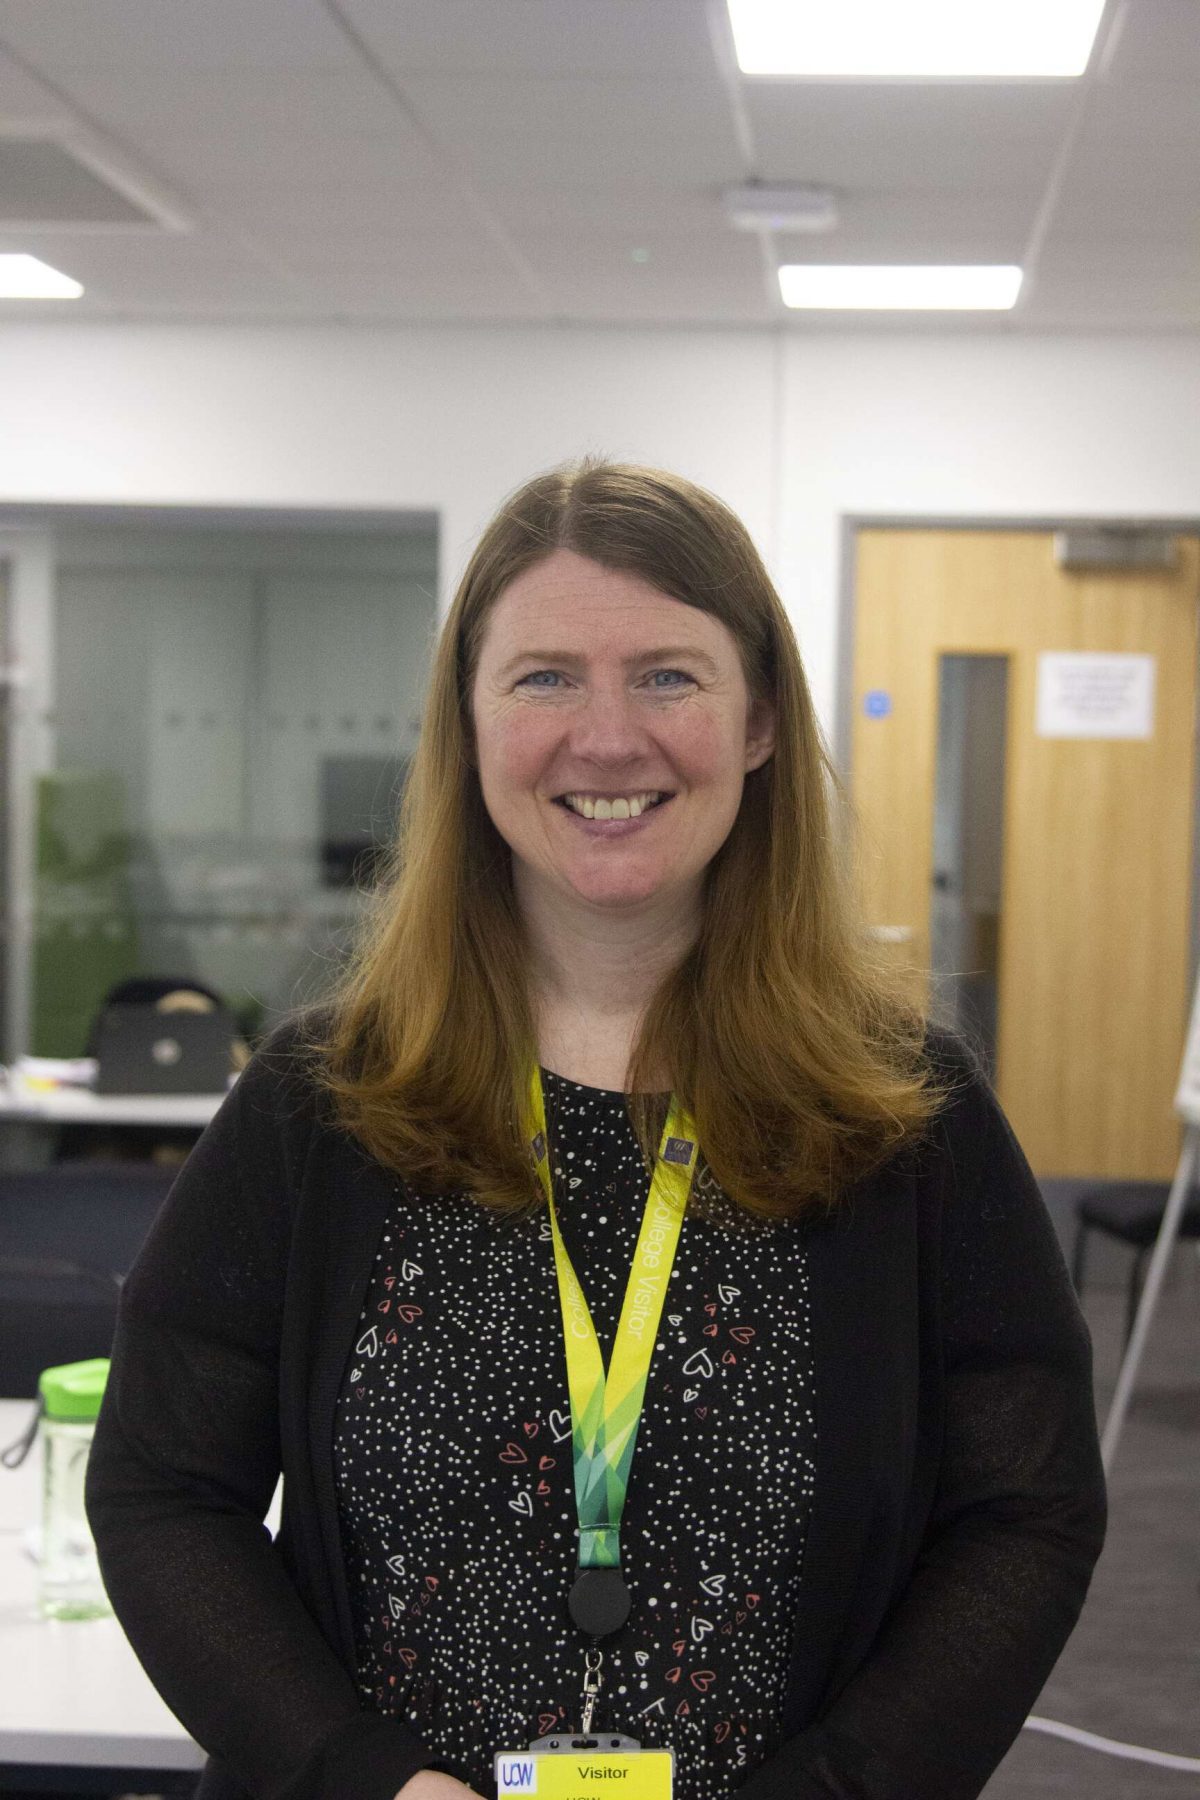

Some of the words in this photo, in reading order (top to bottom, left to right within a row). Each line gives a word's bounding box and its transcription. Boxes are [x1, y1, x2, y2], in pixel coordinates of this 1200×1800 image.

[627, 1275, 660, 1341] Visitor
[502, 1763, 533, 1786] UCW
[577, 1766, 629, 1779] Visitor
